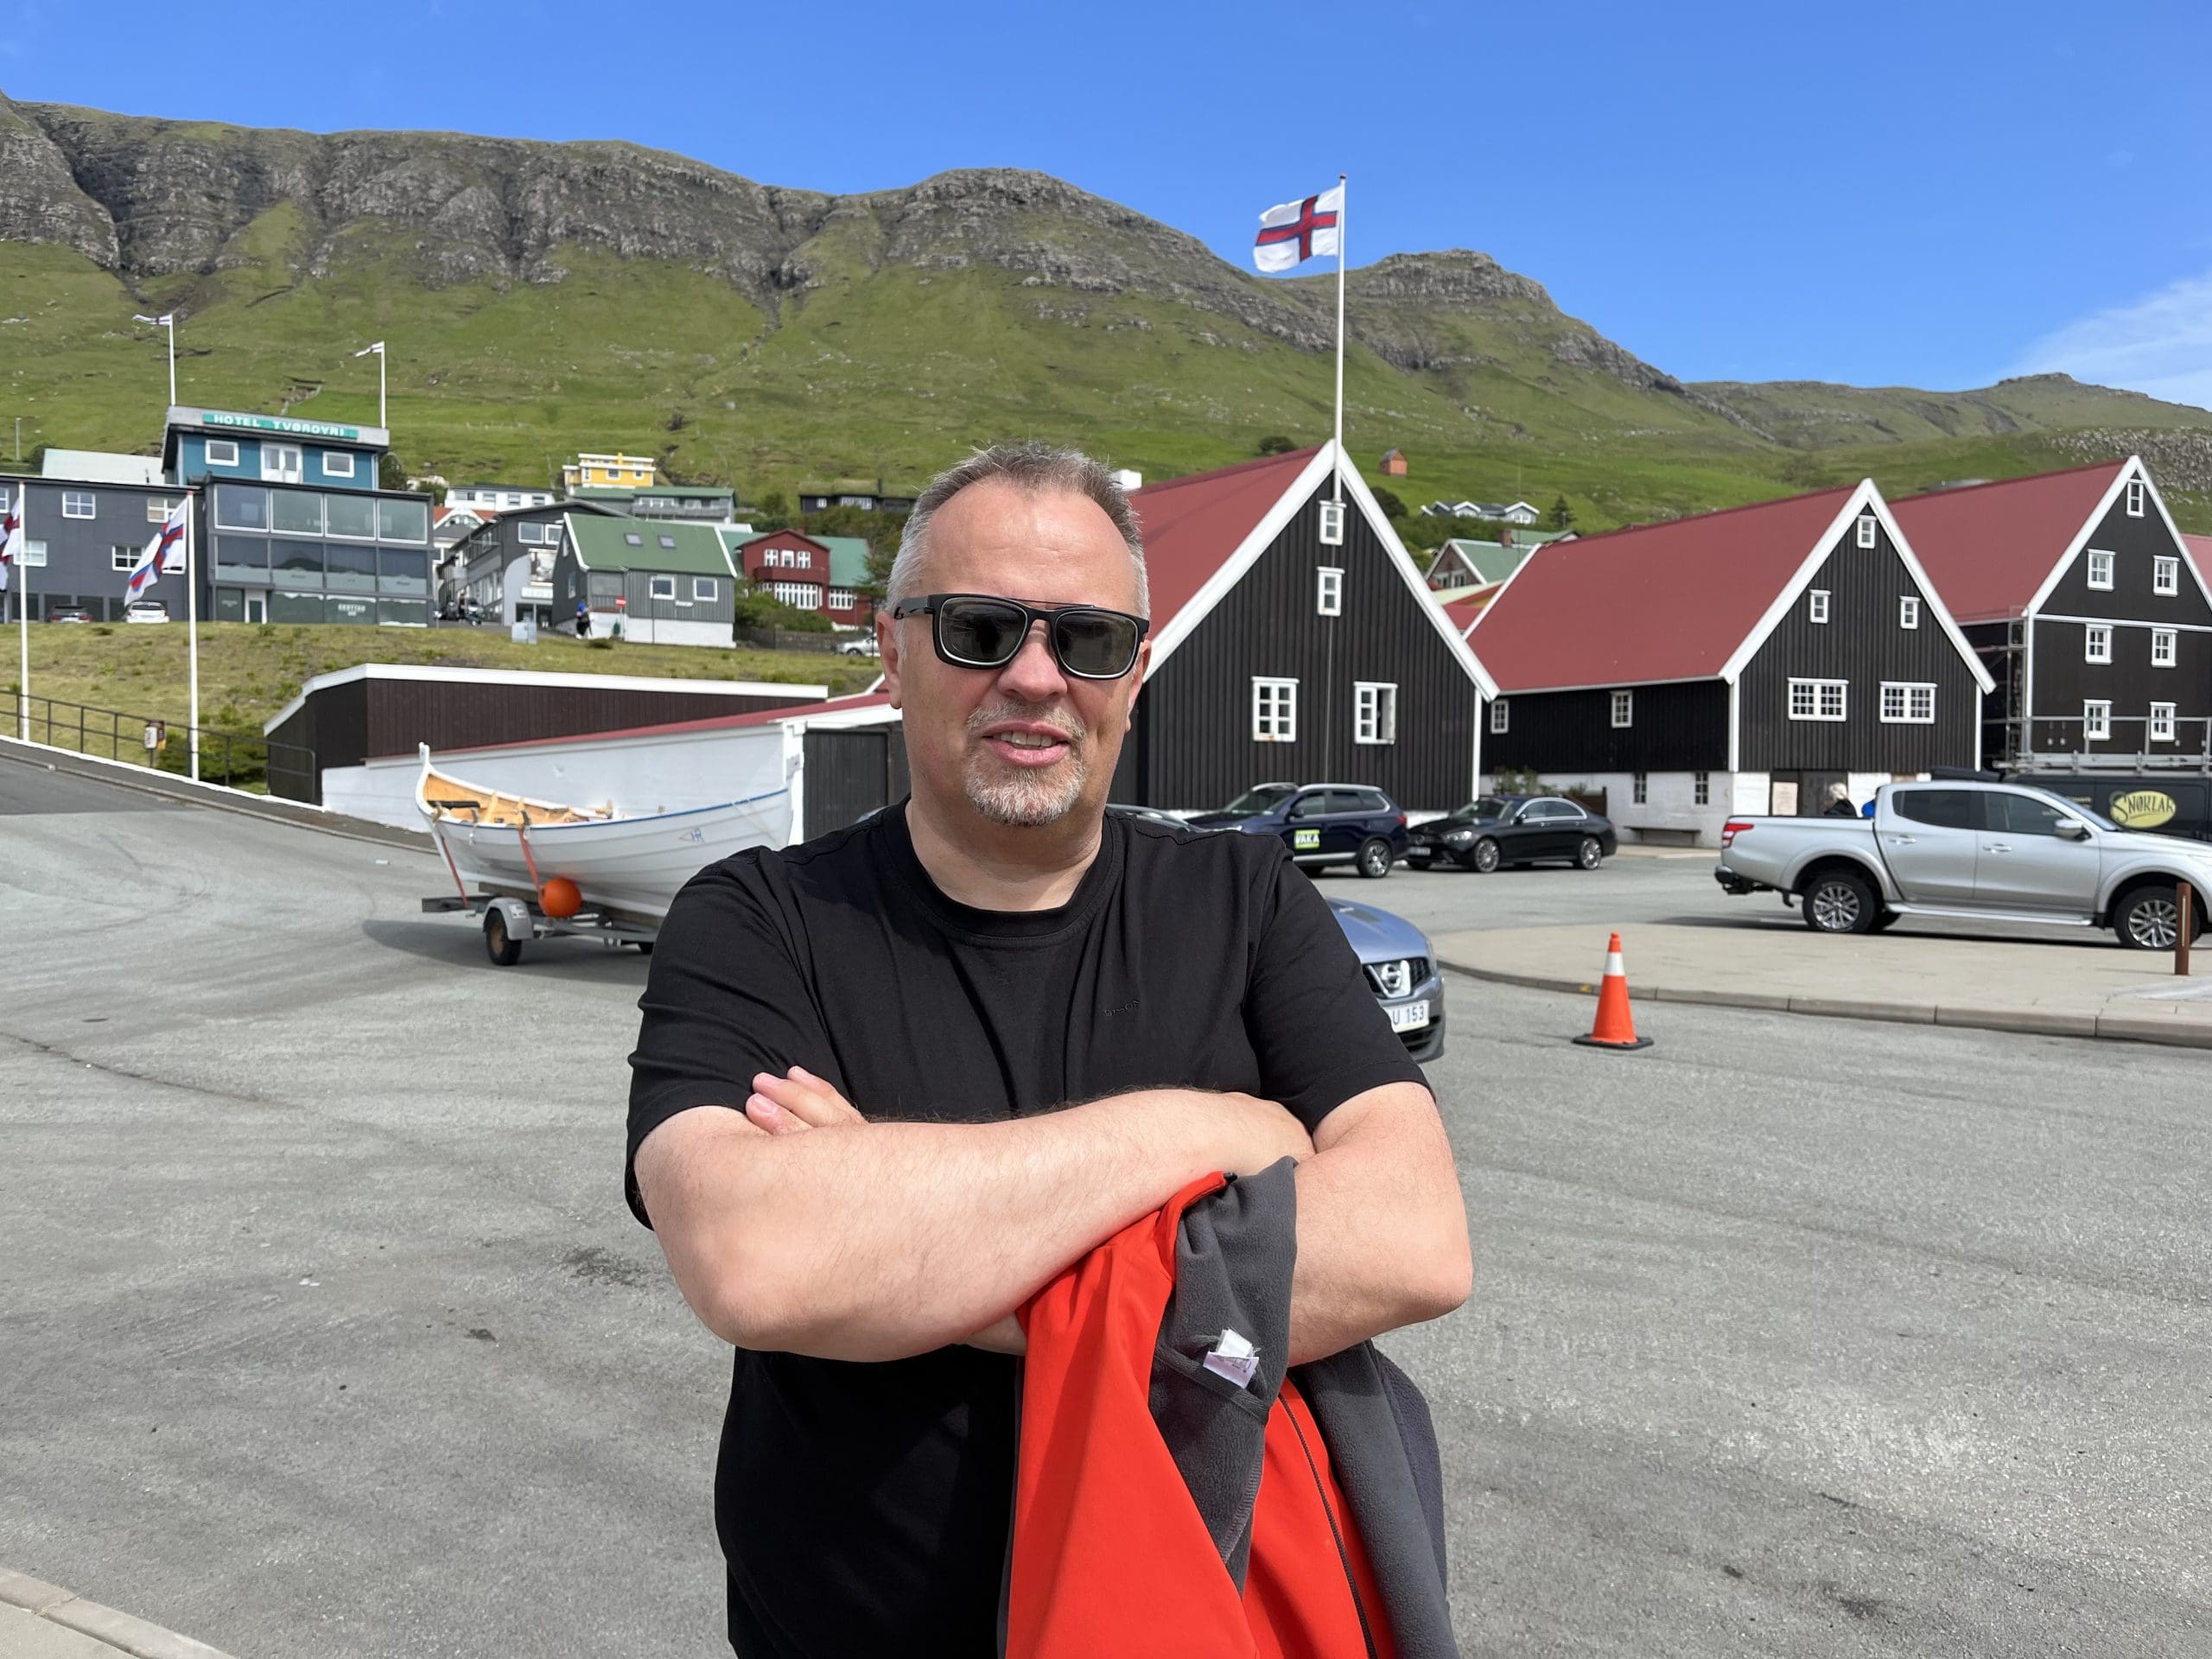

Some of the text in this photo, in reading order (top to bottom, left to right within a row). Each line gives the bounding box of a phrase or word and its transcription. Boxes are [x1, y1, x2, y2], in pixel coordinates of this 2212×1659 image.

[213, 413, 259, 428] HOTEL
[1295, 834, 1319, 844] VAKA
[1406, 1005, 1424, 1024] 153
